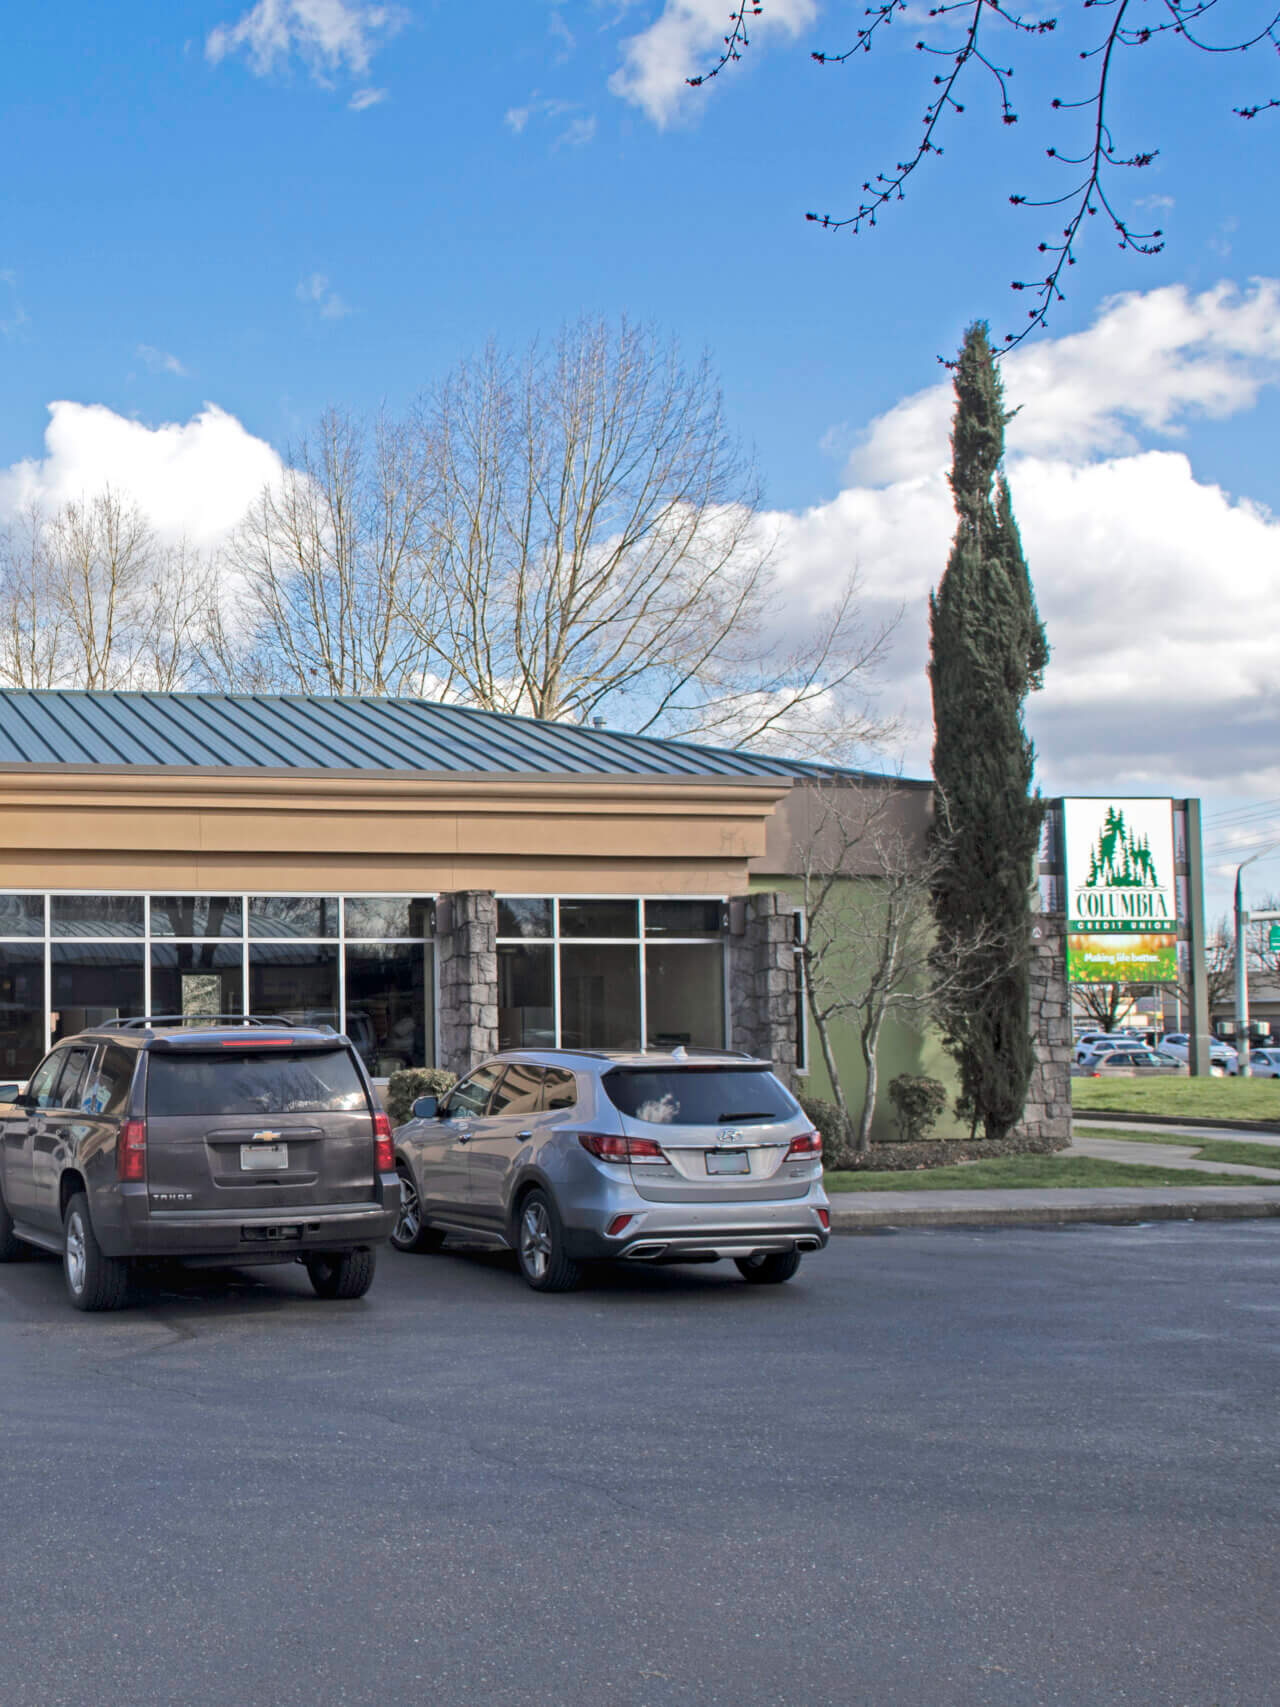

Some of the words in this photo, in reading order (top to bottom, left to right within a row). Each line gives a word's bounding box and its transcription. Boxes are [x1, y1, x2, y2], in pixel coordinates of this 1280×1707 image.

[1076, 893, 1168, 918] COLUMBIA
[1077, 921, 1122, 930] CREDIT
[1130, 921, 1171, 930] UNION
[1084, 952, 1115, 965] Making
